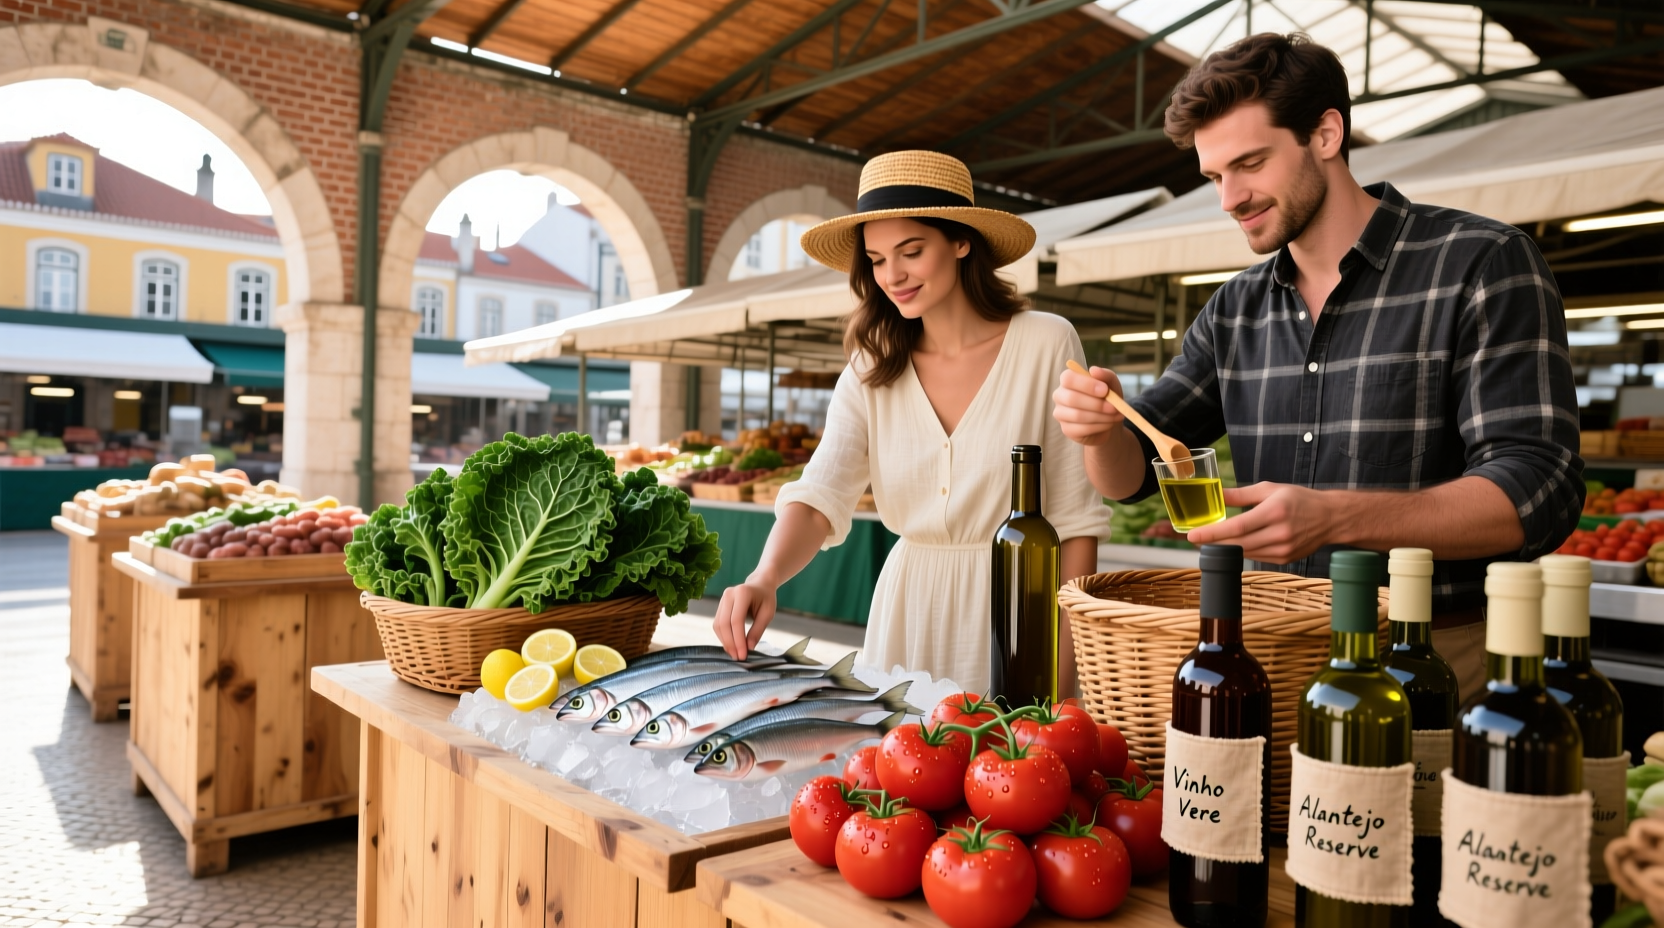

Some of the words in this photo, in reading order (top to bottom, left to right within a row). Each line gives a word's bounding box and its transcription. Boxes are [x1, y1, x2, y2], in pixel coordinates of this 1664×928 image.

[1174, 766, 1224, 797] Vinho
[1179, 797, 1221, 823] Vere
[1298, 794, 1385, 839] Alantejo
[1305, 825, 1379, 859] Reserve
[1457, 828, 1556, 878] Alantejo
[1466, 861, 1552, 898] Reserve
